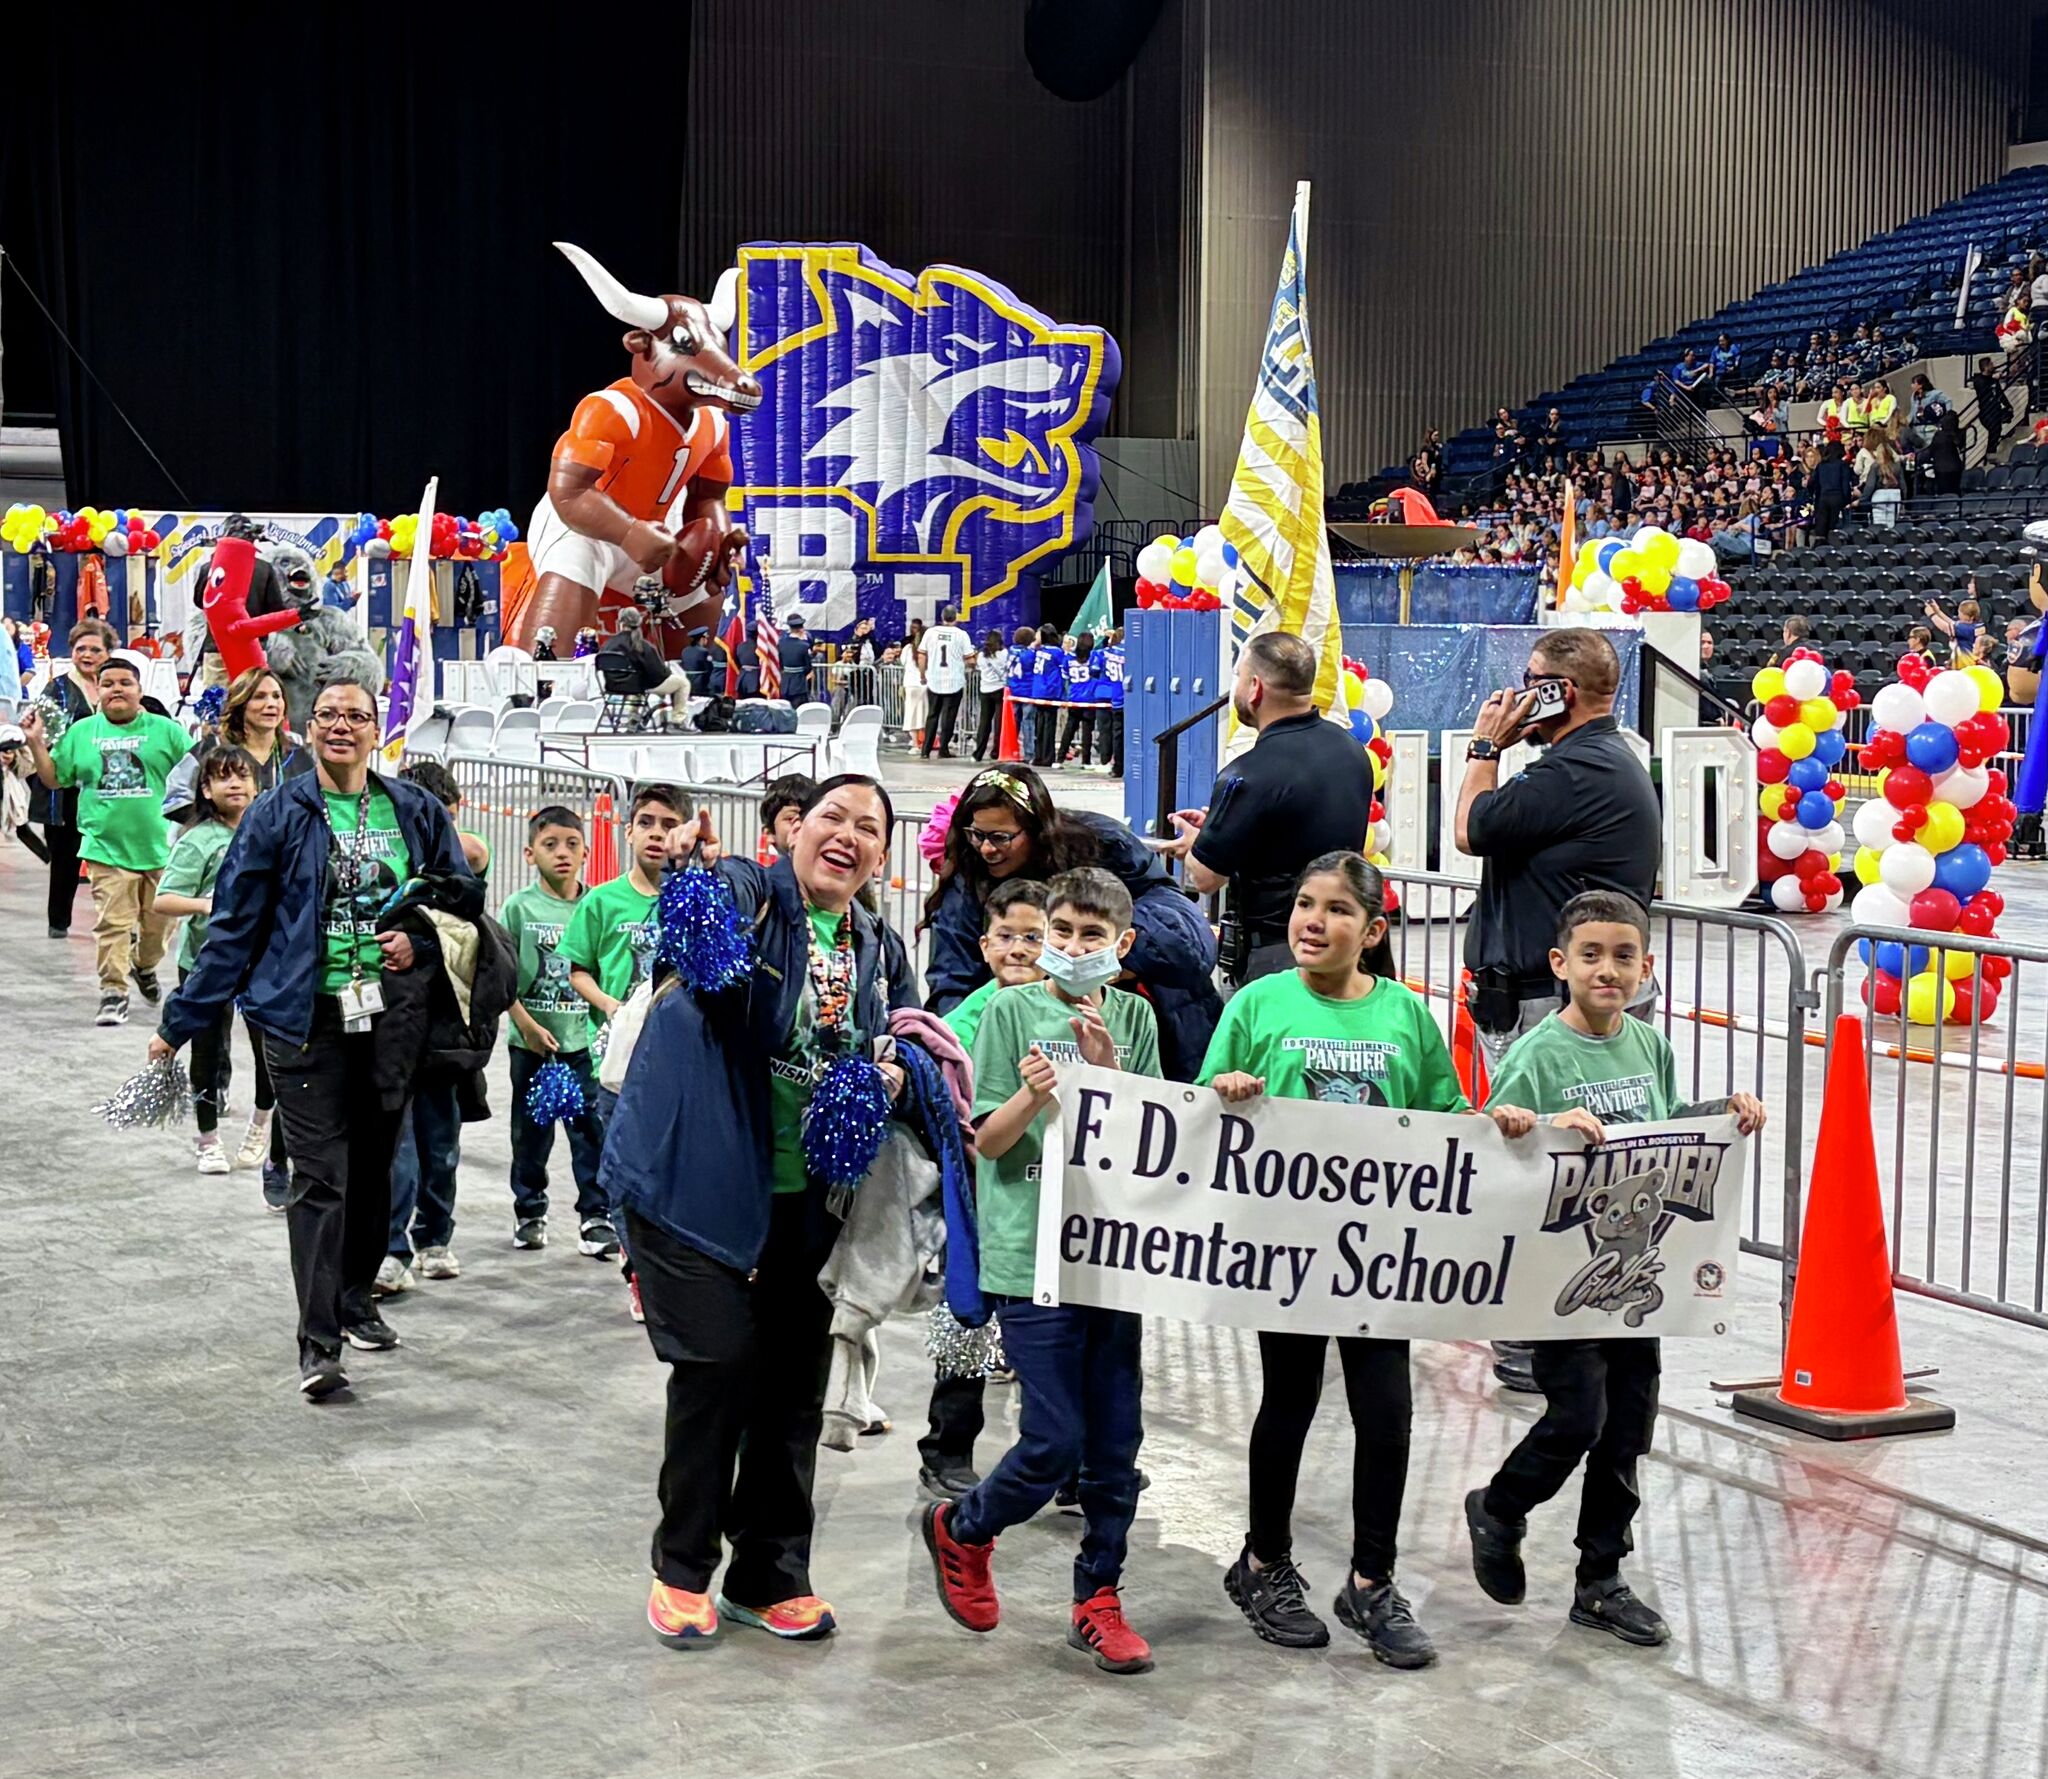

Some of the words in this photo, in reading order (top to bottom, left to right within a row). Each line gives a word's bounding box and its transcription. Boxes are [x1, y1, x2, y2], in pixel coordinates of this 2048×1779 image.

[655, 446, 691, 505] 1
[865, 573, 884, 585] TM
[939, 644, 949, 667] 1
[1068, 666, 1090, 683] 93
[1105, 660, 1123, 682] 91
[1305, 1049, 1386, 1072] PANTHER
[1585, 1086, 1646, 1114] PANTHER
[1069, 1088, 1112, 1171] F.
[1132, 1100, 1190, 1185] D.
[1210, 1113, 1477, 1216] Roosevelt
[1648, 1135, 1699, 1146] ROOSEVELT
[1545, 1143, 1722, 1228] PANTHER
[1060, 1212, 1317, 1307] ementary
[1331, 1221, 1515, 1306] School
[1554, 1246, 1665, 1316] Cubs
